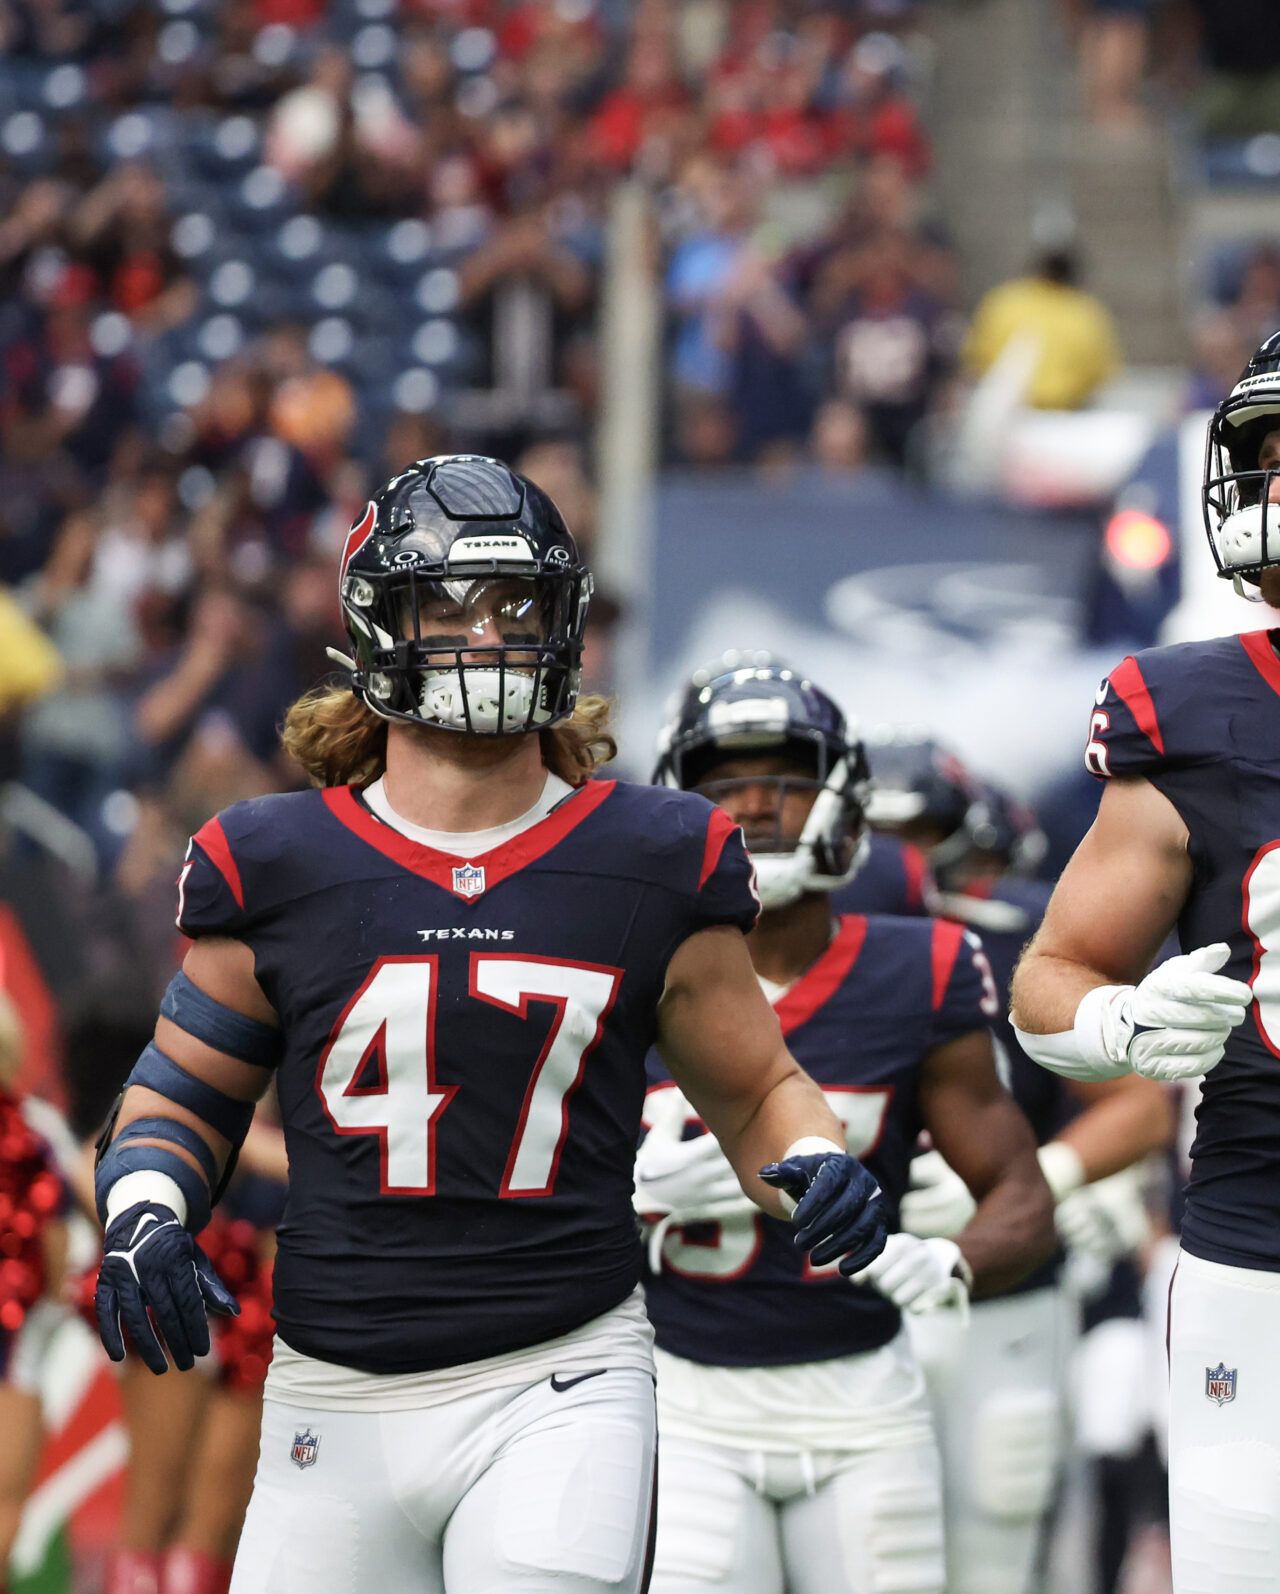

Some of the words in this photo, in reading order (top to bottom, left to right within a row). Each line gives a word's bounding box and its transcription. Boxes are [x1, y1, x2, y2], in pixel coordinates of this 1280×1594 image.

[463, 541, 518, 549] TEXANS
[458, 877, 481, 891] NFL
[416, 927, 515, 942] TEXANS
[314, 951, 625, 1199] 47
[1210, 1381, 1231, 1398] NFL
[294, 1445, 313, 1461] NFL
